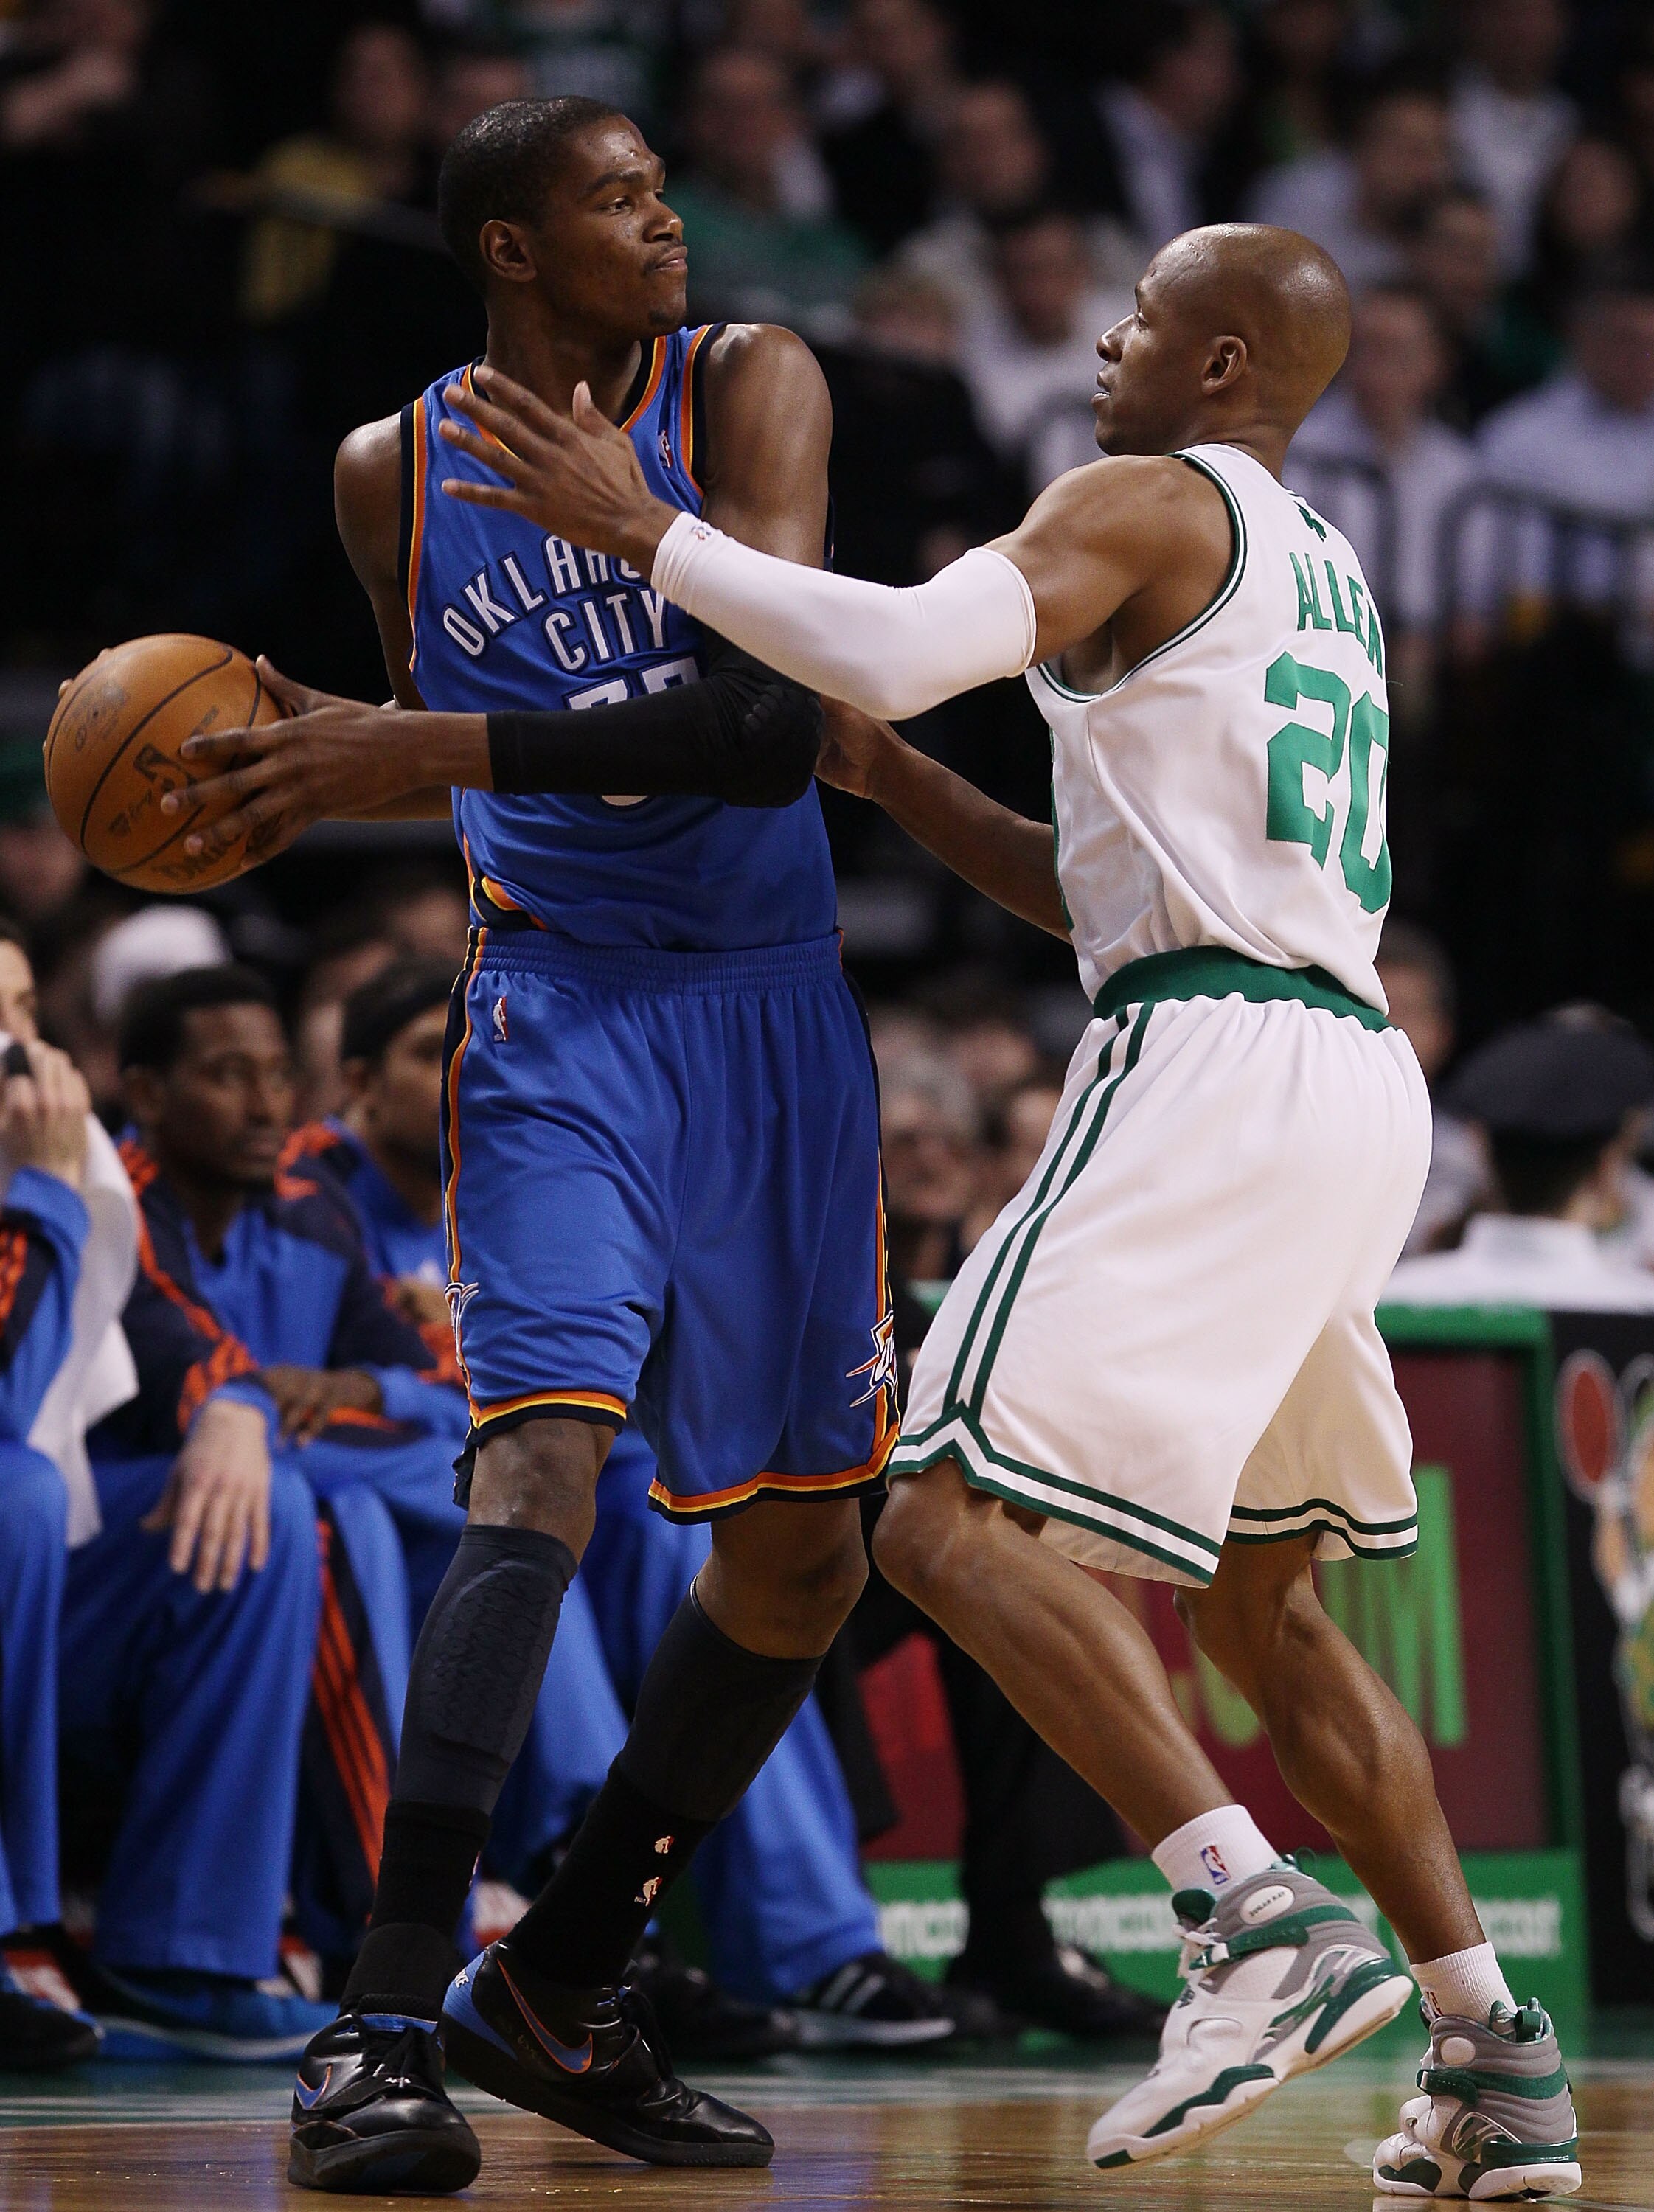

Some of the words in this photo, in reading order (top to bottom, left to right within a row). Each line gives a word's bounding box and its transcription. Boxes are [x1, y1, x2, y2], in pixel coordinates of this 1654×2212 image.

[545, 589, 664, 670] CITY
[1289, 552, 1383, 679] ALLEN
[1265, 651, 1392, 914] 20
